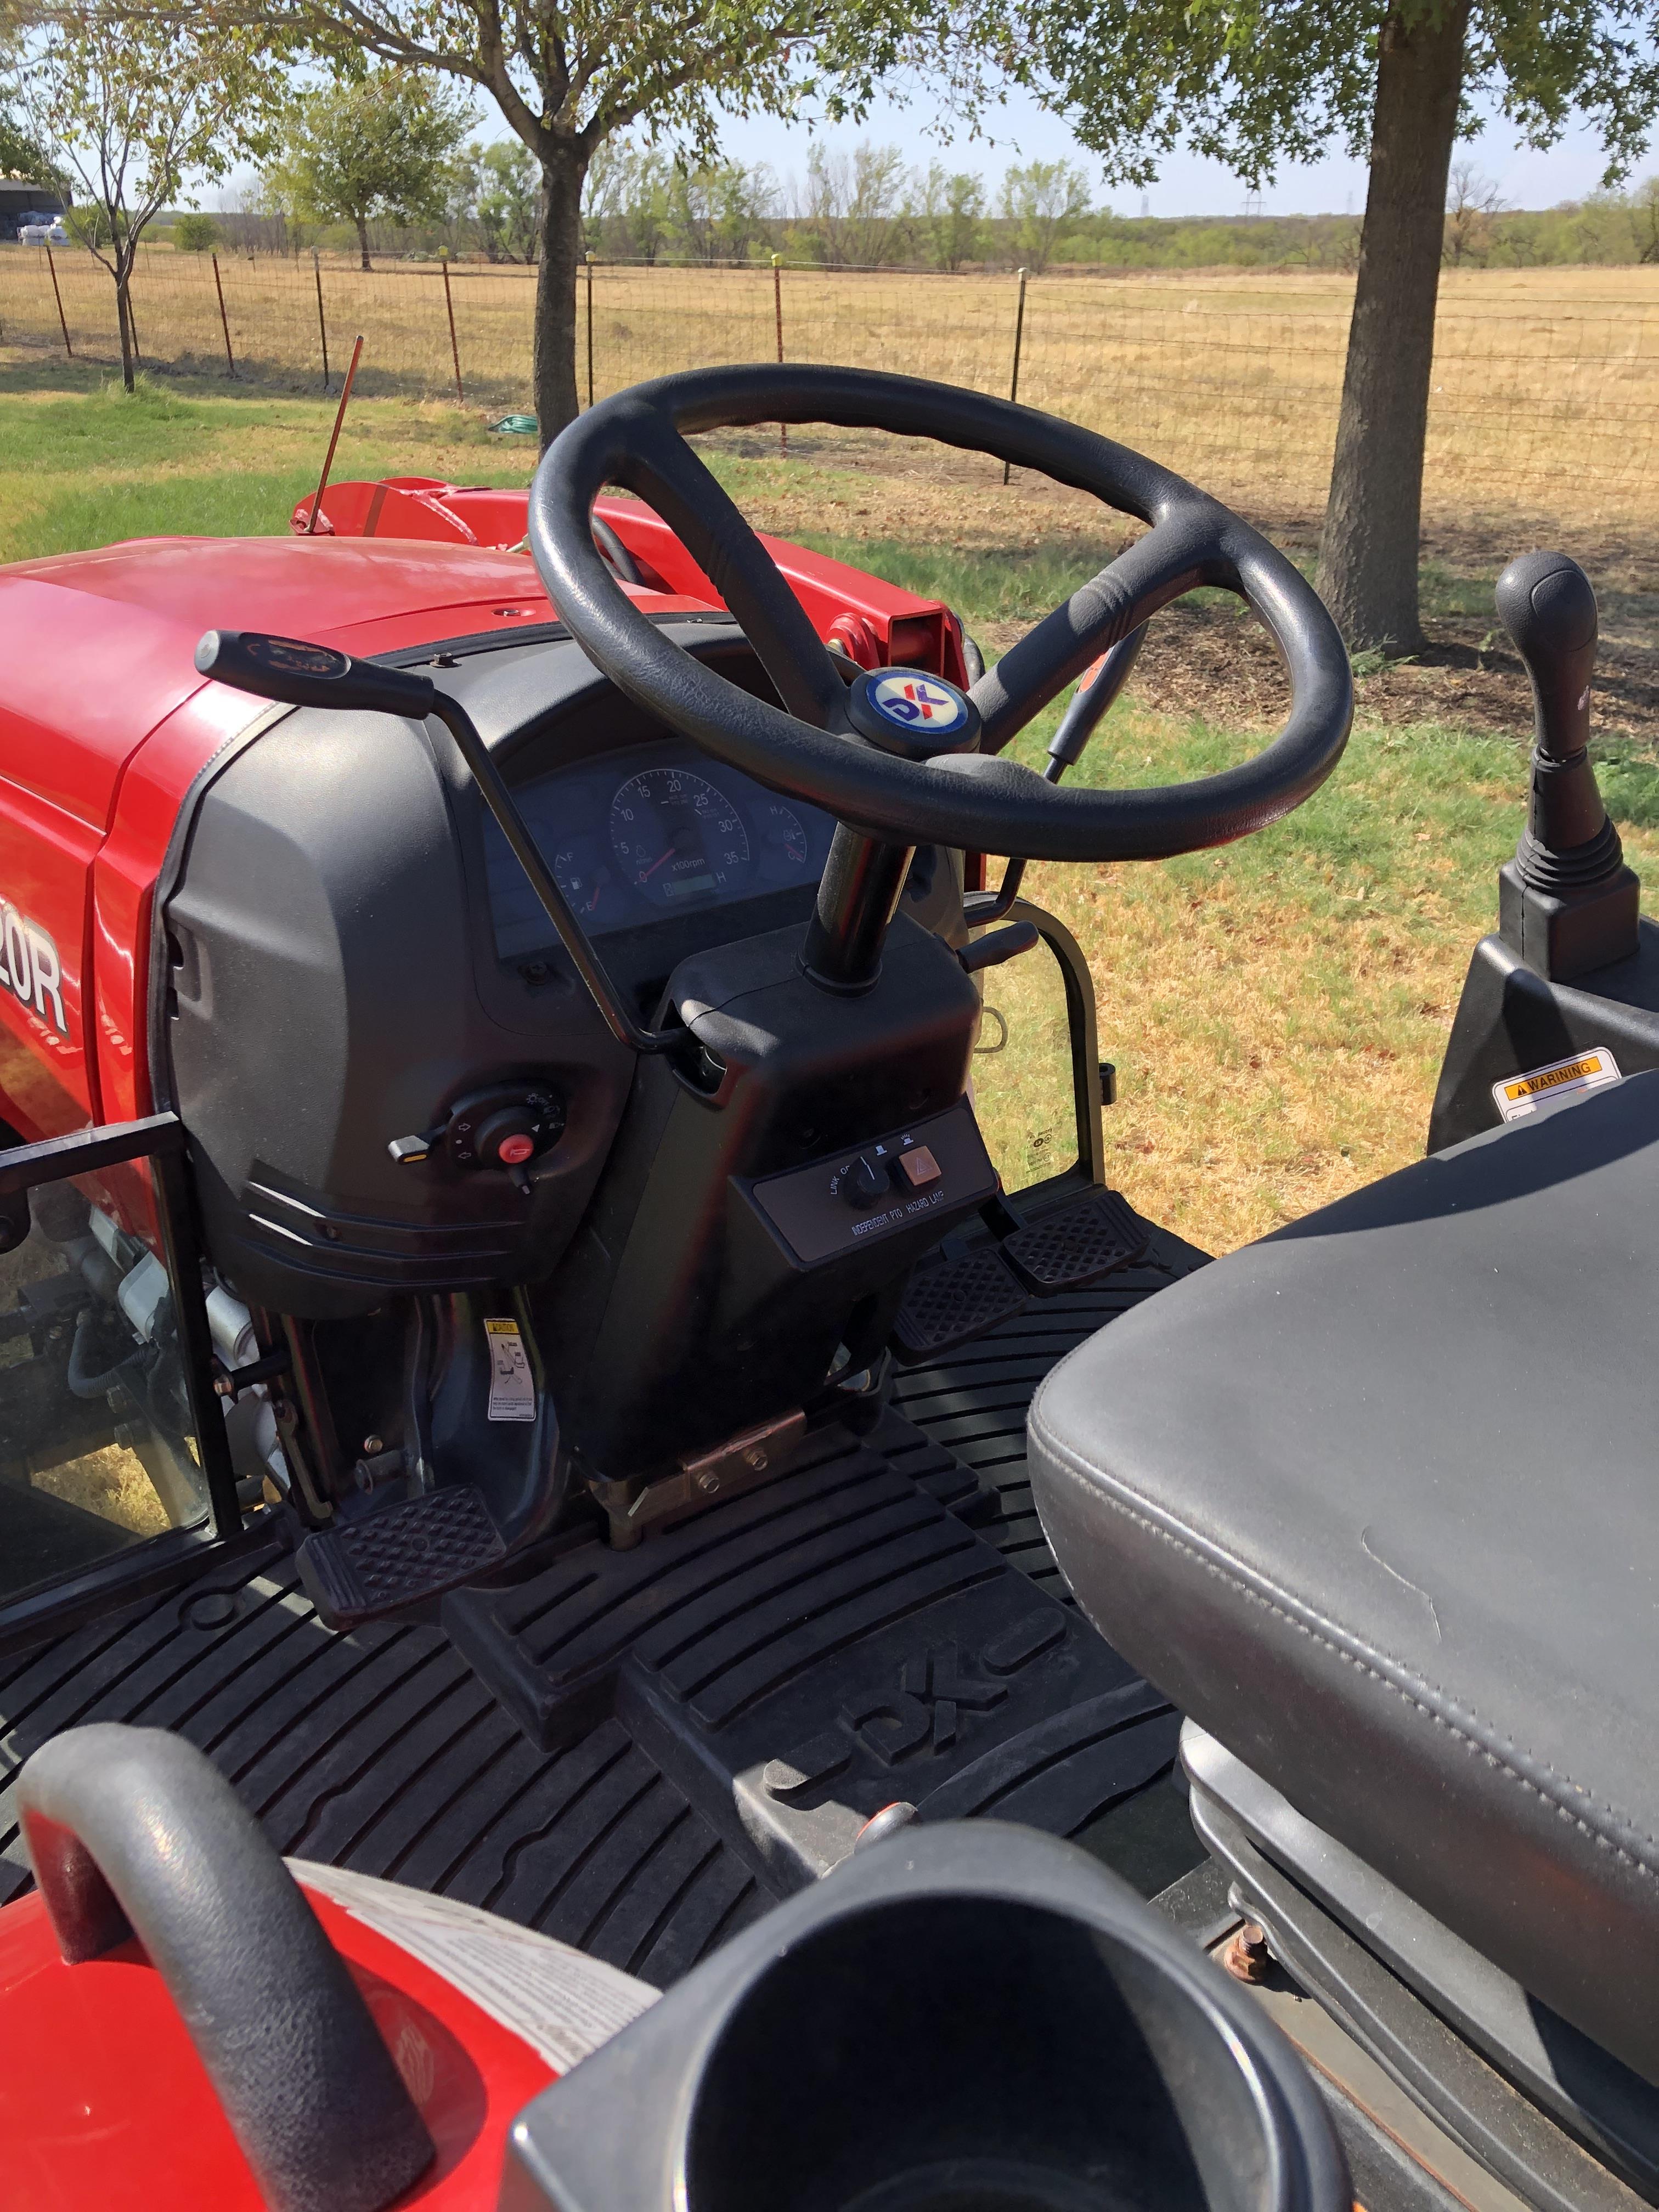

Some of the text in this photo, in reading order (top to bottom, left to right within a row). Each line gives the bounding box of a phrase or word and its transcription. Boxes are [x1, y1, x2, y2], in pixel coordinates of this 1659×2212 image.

[637, 786, 650, 798] 15
[667, 780, 681, 792] 20
[693, 793, 708, 806] 25
[620, 809, 634, 821] 10
[769, 806, 778, 815] H
[718, 819, 733, 832] 30
[620, 842, 629, 854] 5
[567, 852, 573, 861] F
[724, 851, 739, 865] 35
[671, 858, 706, 872] x100rpm
[715, 871, 727, 884] H
[586, 901, 592, 911] E
[1527, 1063, 1591, 1091] WARINING
[830, 1176, 840, 1194] LINK
[906, 1190, 944, 1214] HAZARD LAMP
[851, 1209, 903, 1235] INDEPENDENT PTO
